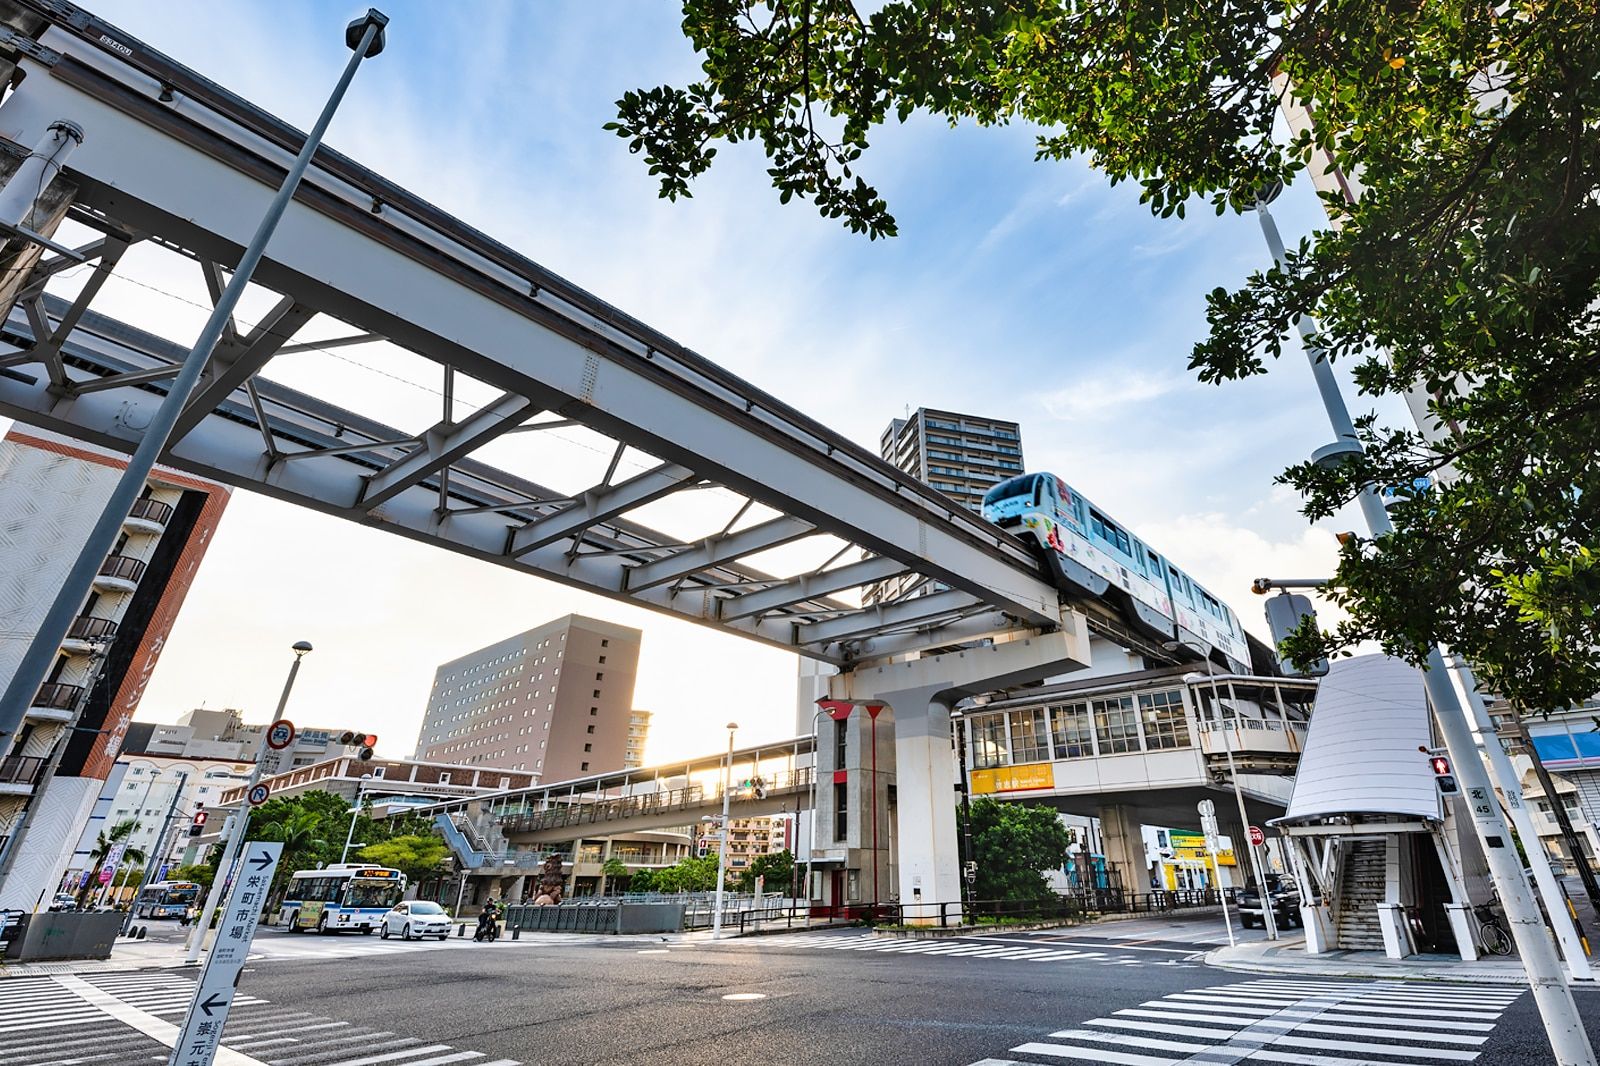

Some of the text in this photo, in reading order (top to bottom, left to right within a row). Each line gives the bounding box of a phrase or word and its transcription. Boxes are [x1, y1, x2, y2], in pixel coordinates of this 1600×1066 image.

[1471, 789, 1484, 800] 北
[1476, 805, 1490, 814] 45
[229, 875, 260, 940] 栄町市場
[242, 917, 255, 943] Market
